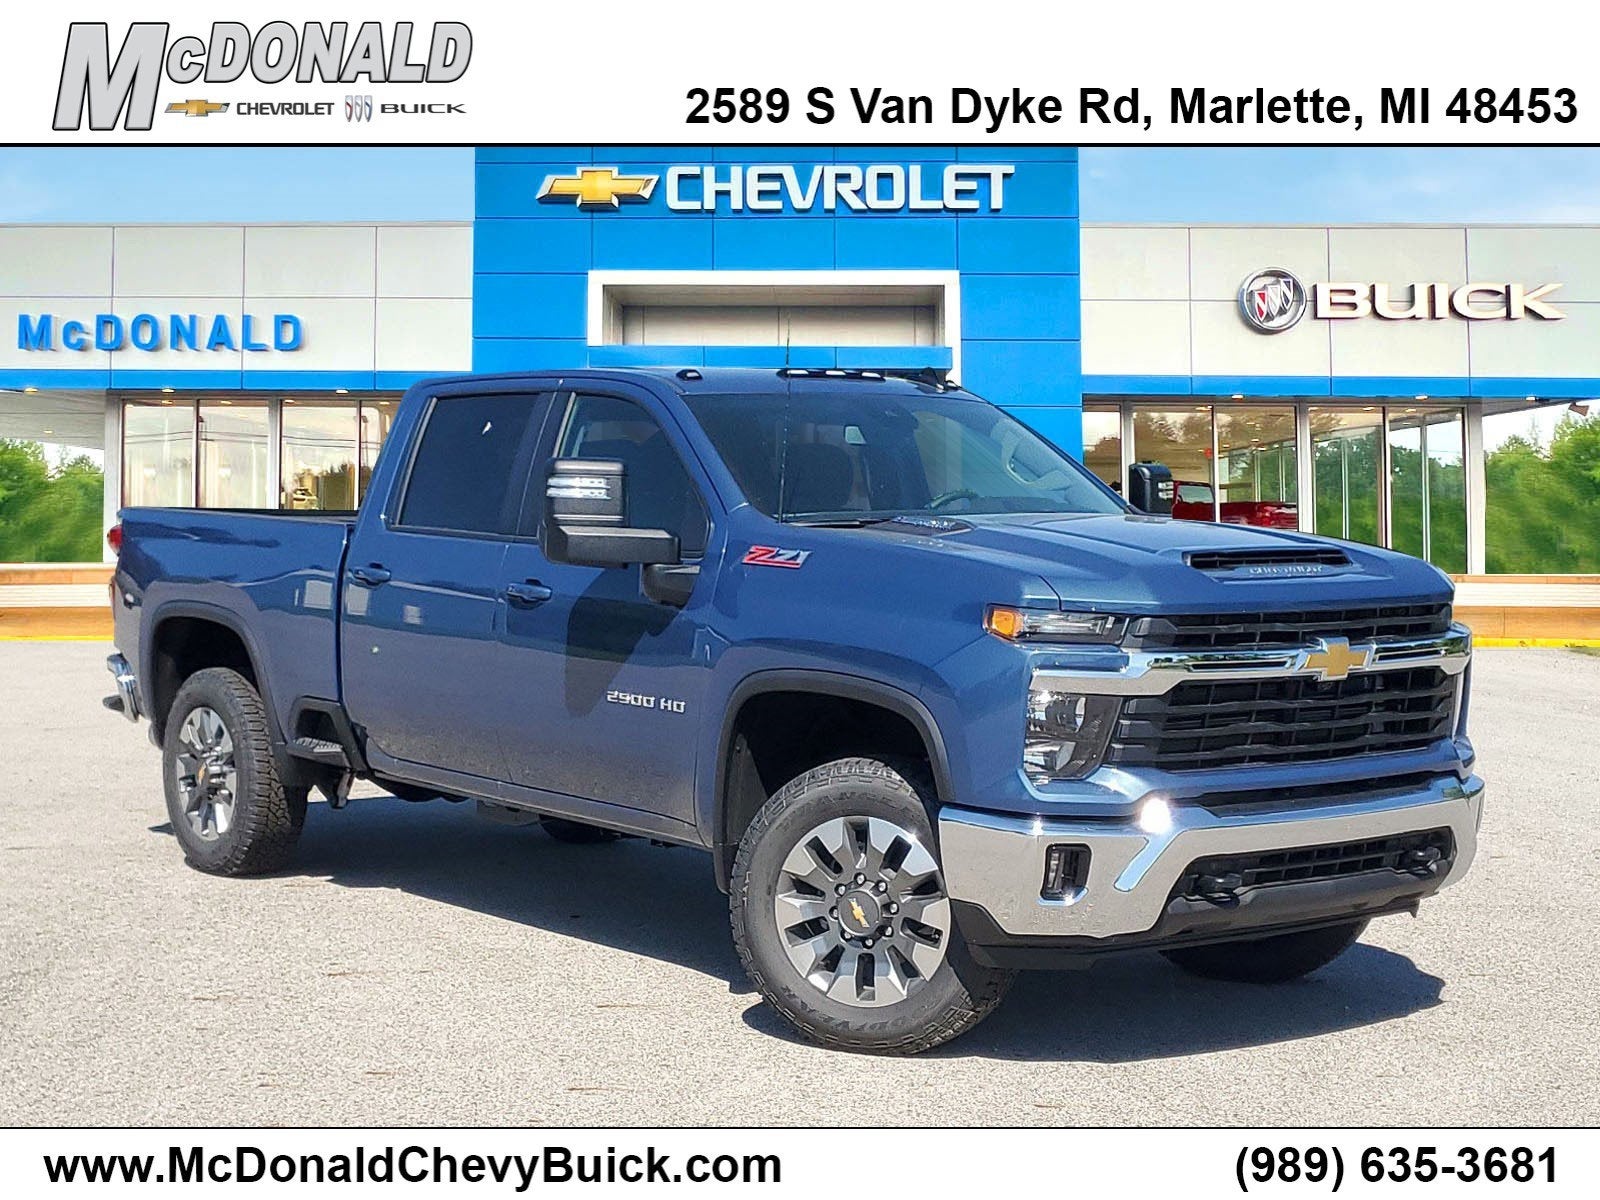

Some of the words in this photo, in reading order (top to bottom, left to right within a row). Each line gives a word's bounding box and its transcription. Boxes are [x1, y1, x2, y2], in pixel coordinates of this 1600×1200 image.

[666, 164, 1015, 210] CHEVROLET
[1313, 282, 1567, 320] BUICK
[17, 313, 305, 352] McDONALD
[742, 545, 811, 568] Z71
